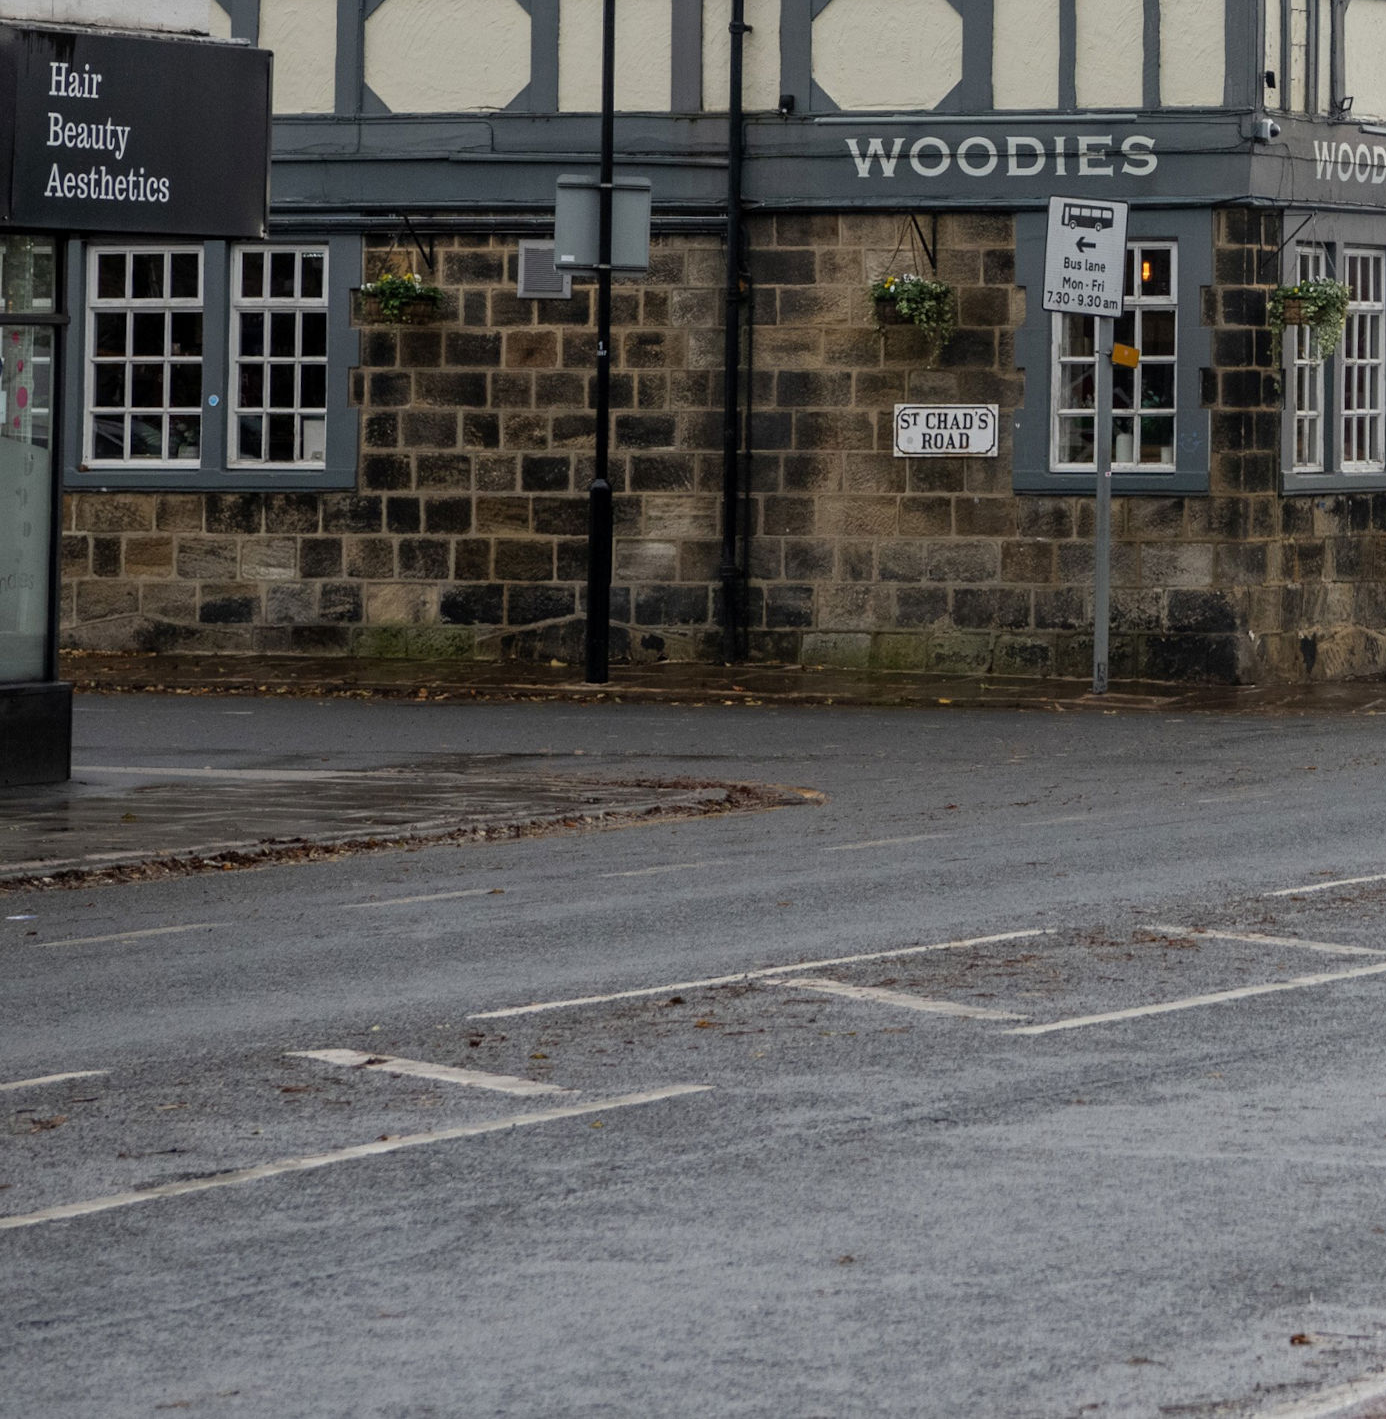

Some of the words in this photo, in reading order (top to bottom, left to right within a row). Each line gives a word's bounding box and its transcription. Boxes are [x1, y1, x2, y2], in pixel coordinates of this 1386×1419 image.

[48, 61, 102, 99] Hair
[46, 111, 131, 160] Beauty
[844, 135, 1159, 178] WOODIES
[44, 162, 170, 203] Aesthetics
[1063, 256, 1082, 271] Bus
[1085, 259, 1106, 273] lane
[1062, 276, 1083, 290] Mon
[1091, 279, 1105, 292] Fri
[1047, 290, 1070, 305] 7.30
[1077, 294, 1101, 308] 9.30
[1103, 298, 1118, 310] am
[925, 410, 989, 430] CHAD'S
[921, 432, 970, 450] ROAD
